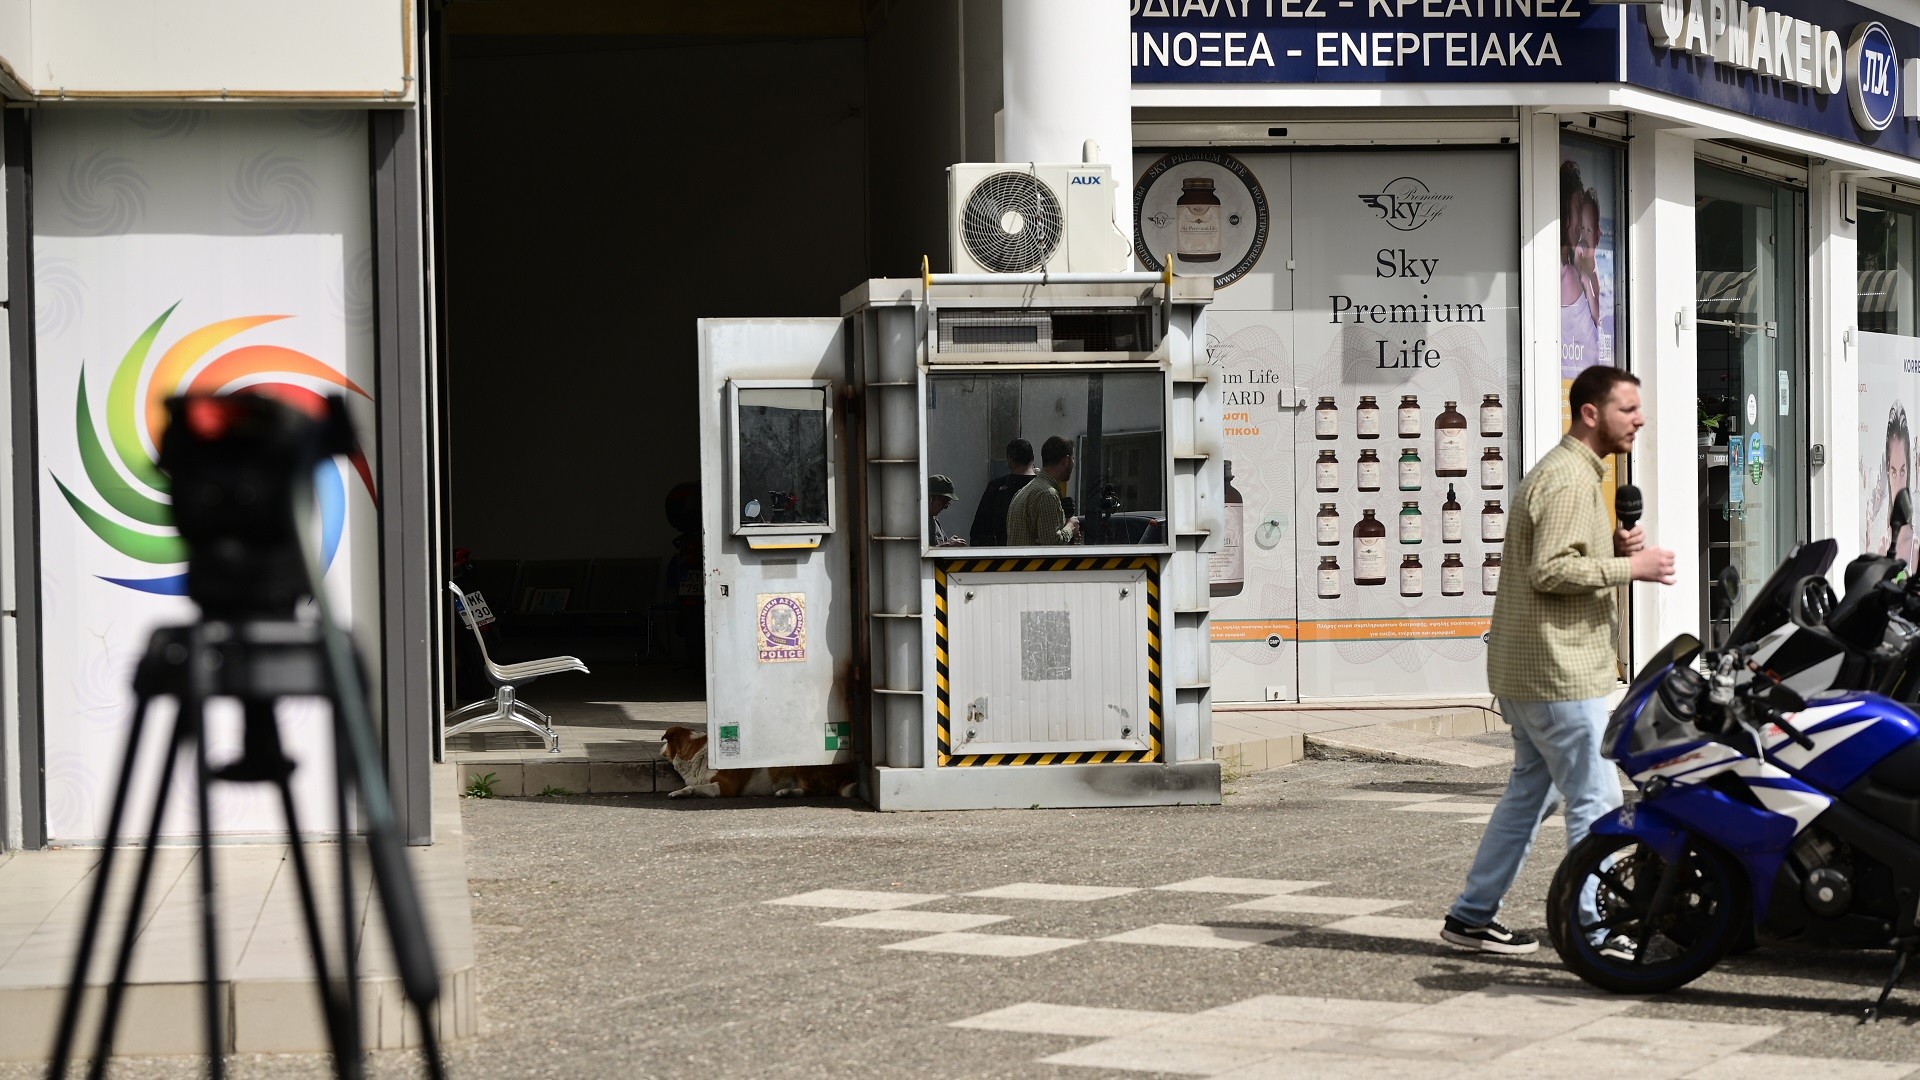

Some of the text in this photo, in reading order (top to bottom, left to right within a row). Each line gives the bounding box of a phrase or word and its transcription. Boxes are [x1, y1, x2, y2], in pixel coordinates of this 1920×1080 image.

[1368, 0, 1581, 18] ΚΡΕΑΤΙΝΕΣ
[1131, 31, 1276, 67] ΙΝΟΞΕΑ
[1316, 31, 1563, 67] ΕΝΕΡΓΕΙΑΚΑ
[1653, 0, 1843, 95] ΦΑΡΜΑΚΕΙΟ
[1148, 152, 1247, 179] SKY PREMIUM LIFE
[1070, 175, 1102, 186] AUX
[1399, 184, 1455, 200] Premium
[1358, 193, 1422, 227] Sky
[1417, 201, 1448, 222] Life
[1215, 184, 1268, 287] WWW.SKYPREMIUMLIFE.COM
[1375, 248, 1440, 285] Sky
[1328, 292, 1487, 325] Premium
[1374, 339, 1442, 370] Life
[1248, 369, 1280, 384] Life
[1222, 426, 1260, 436] τικού
[467, 593, 484, 606] MK
[760, 597, 803, 638] ΕΛΛΗΝΙΚΗ ΑΣΤΥΝΟΜΙΑ
[760, 650, 804, 659] POLICE
